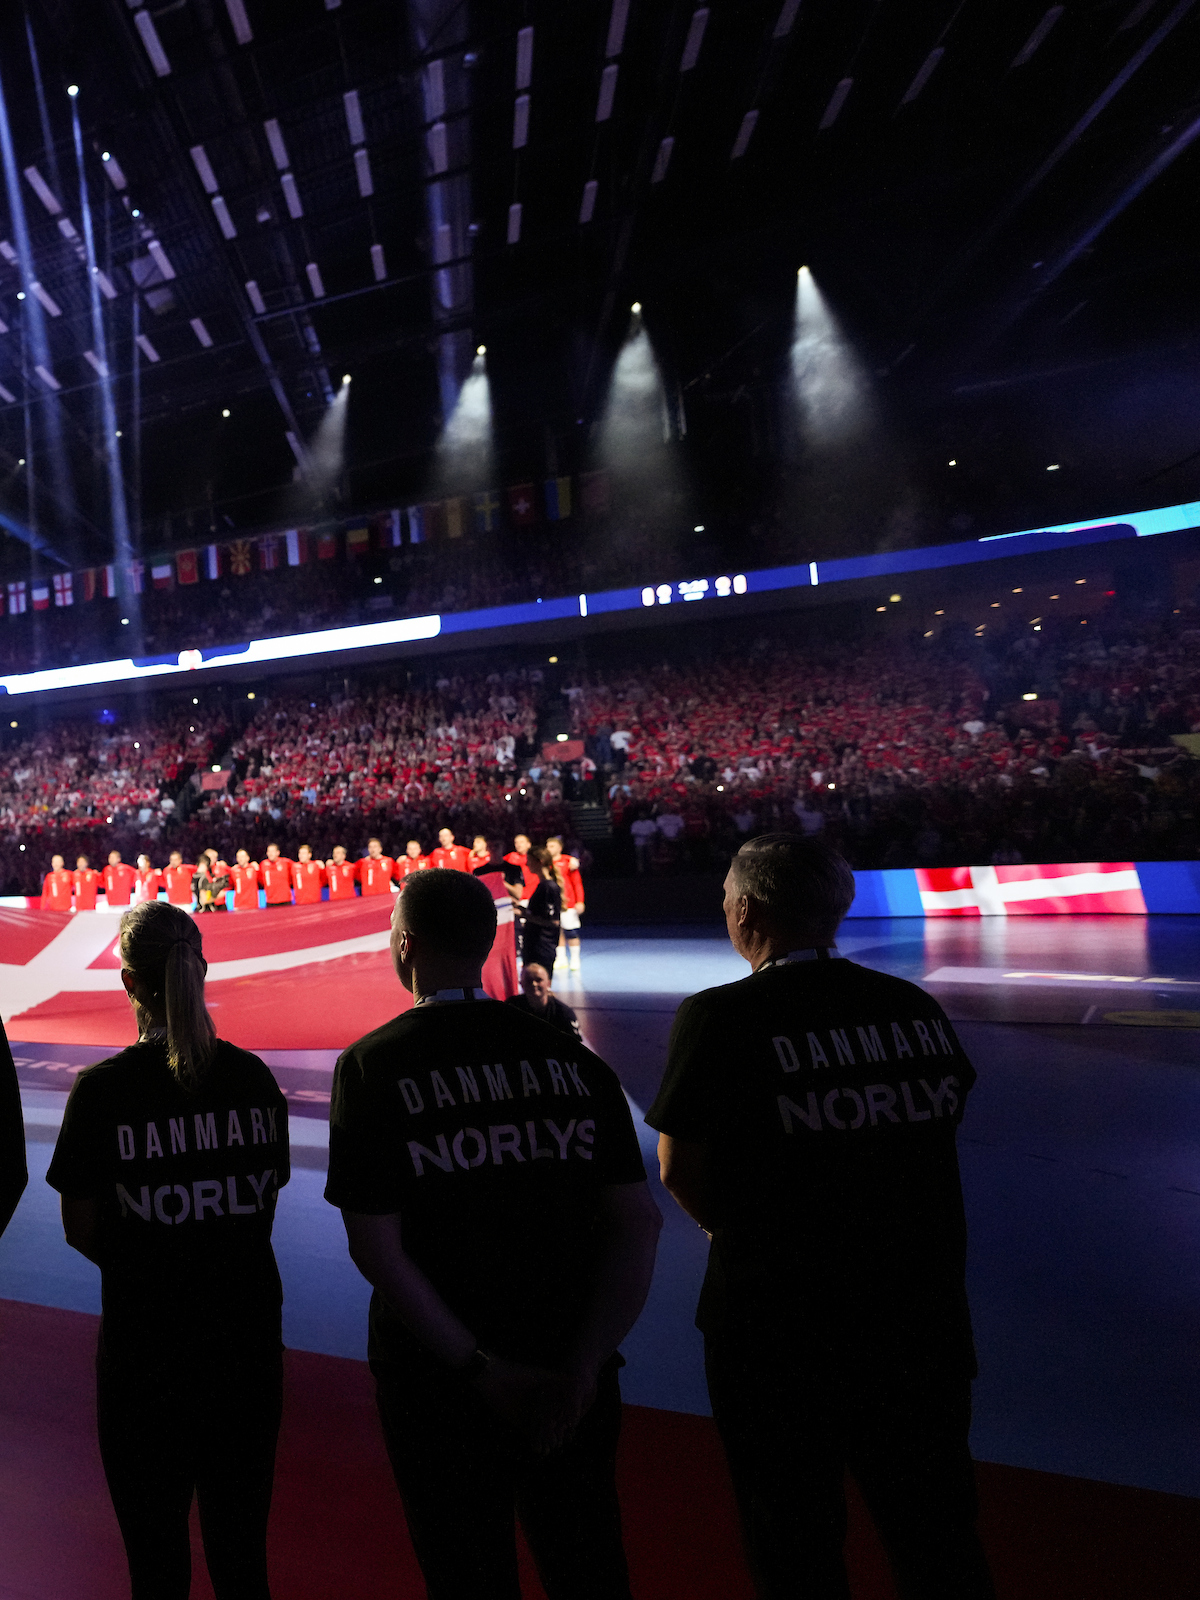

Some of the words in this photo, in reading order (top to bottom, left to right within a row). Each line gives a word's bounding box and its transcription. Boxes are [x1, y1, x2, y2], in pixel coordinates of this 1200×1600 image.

[771, 1018, 954, 1073] DANMARK
[397, 1057, 592, 1115] DANMARK
[776, 1075, 961, 1134] NORLYS
[117, 1107, 278, 1161] DANMARK
[406, 1118, 596, 1177] NORLYS
[115, 1168, 279, 1226] NORLY
